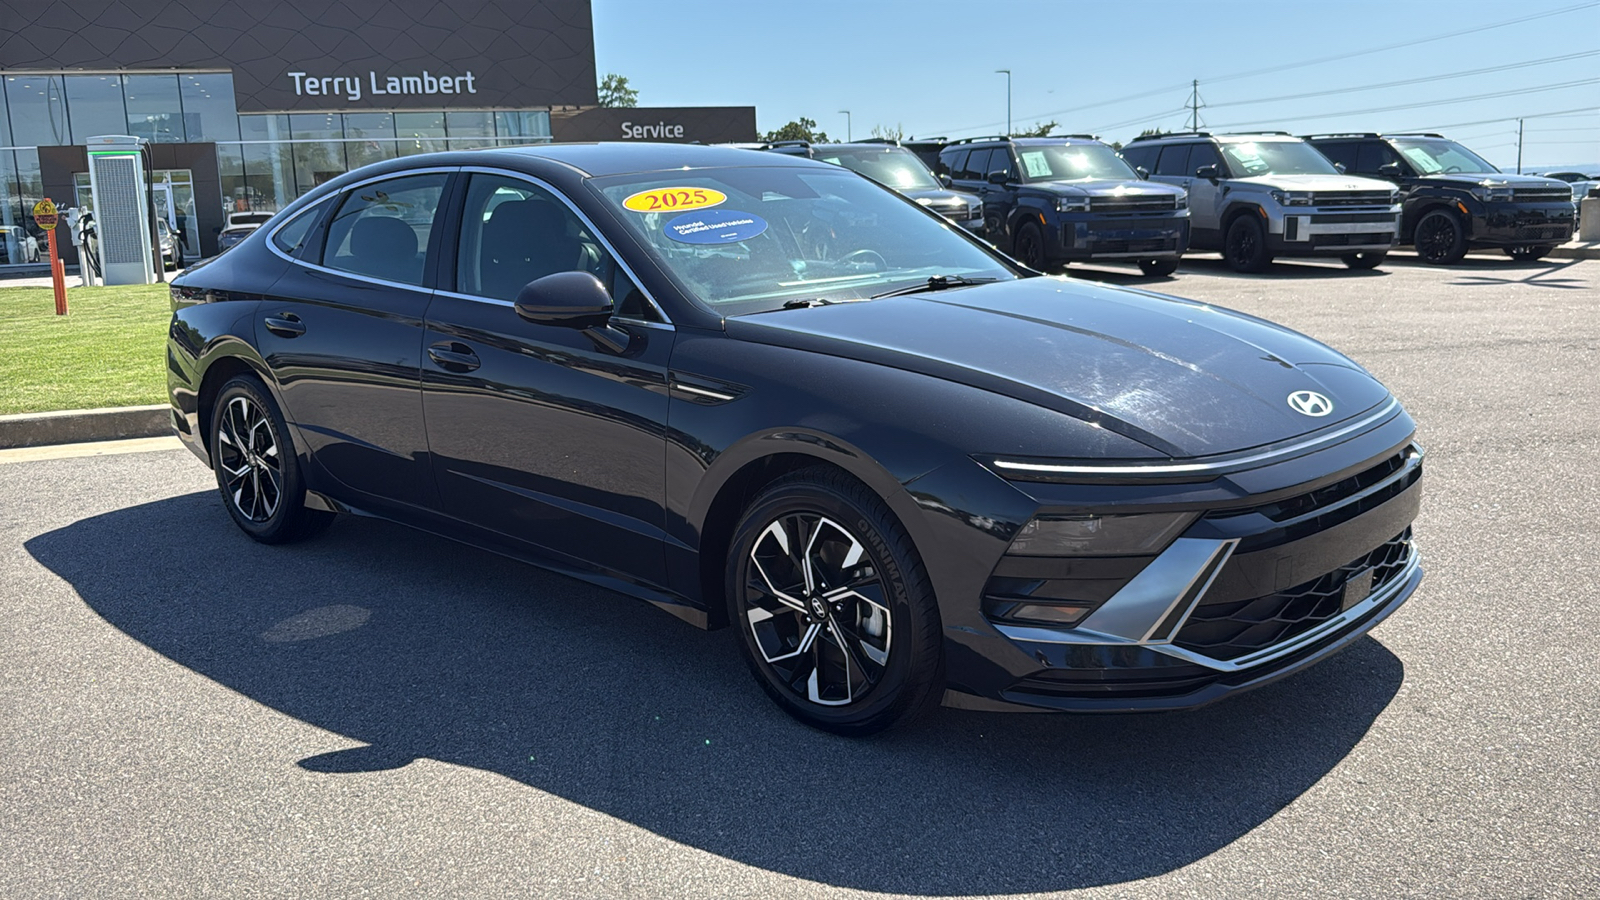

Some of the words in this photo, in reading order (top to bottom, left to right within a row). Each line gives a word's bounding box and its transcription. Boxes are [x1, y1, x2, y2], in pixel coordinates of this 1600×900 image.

[288, 72, 361, 101] Terry
[370, 70, 477, 95] Lambert
[621, 121, 684, 139] Service
[645, 190, 708, 210] 2025
[673, 220, 704, 231] Hyundai
[679, 225, 709, 235] Certified
[709, 222, 727, 230] Used
[725, 218, 754, 227] Vehicles
[857, 519, 908, 605] OMNIMAX
